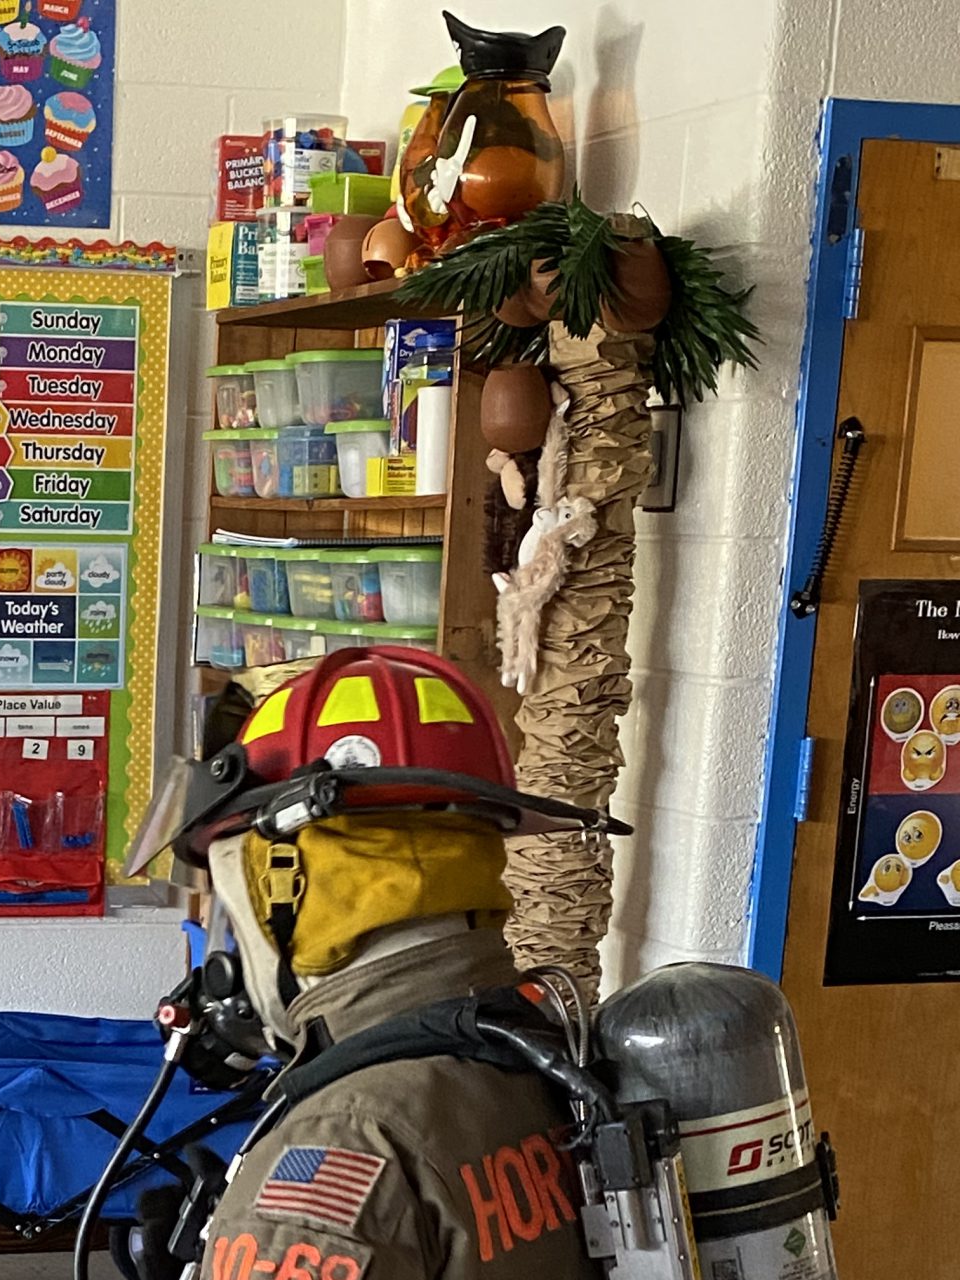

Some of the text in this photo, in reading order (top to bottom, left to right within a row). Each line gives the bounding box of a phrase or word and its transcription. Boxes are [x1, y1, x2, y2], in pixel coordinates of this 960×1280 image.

[60, 70, 78, 81] JUNE
[0, 129, 26, 139] AUGUST
[227, 176, 265, 190] BALANC
[32, 310, 101, 334] Sunday
[28, 342, 105, 367] Monday
[28, 376, 102, 400] Tuesday
[10, 409, 116, 434] Wednesday
[22, 442, 105, 467] Thursday
[34, 474, 90, 499] Friday
[20, 506, 101, 529] Saturday
[44, 578, 67, 587] cloudy
[46, 571, 66, 580] partly
[88, 570, 110, 579] cloudy
[5, 601, 59, 619] Today's
[916, 599, 948, 618] The
[1, 620, 64, 634] Weather
[30, 699, 61, 710] Value
[32, 743, 40, 755] 2
[78, 745, 86, 756] 9
[847, 778, 861, 815] Energy
[460, 1130, 576, 1262] HOR
